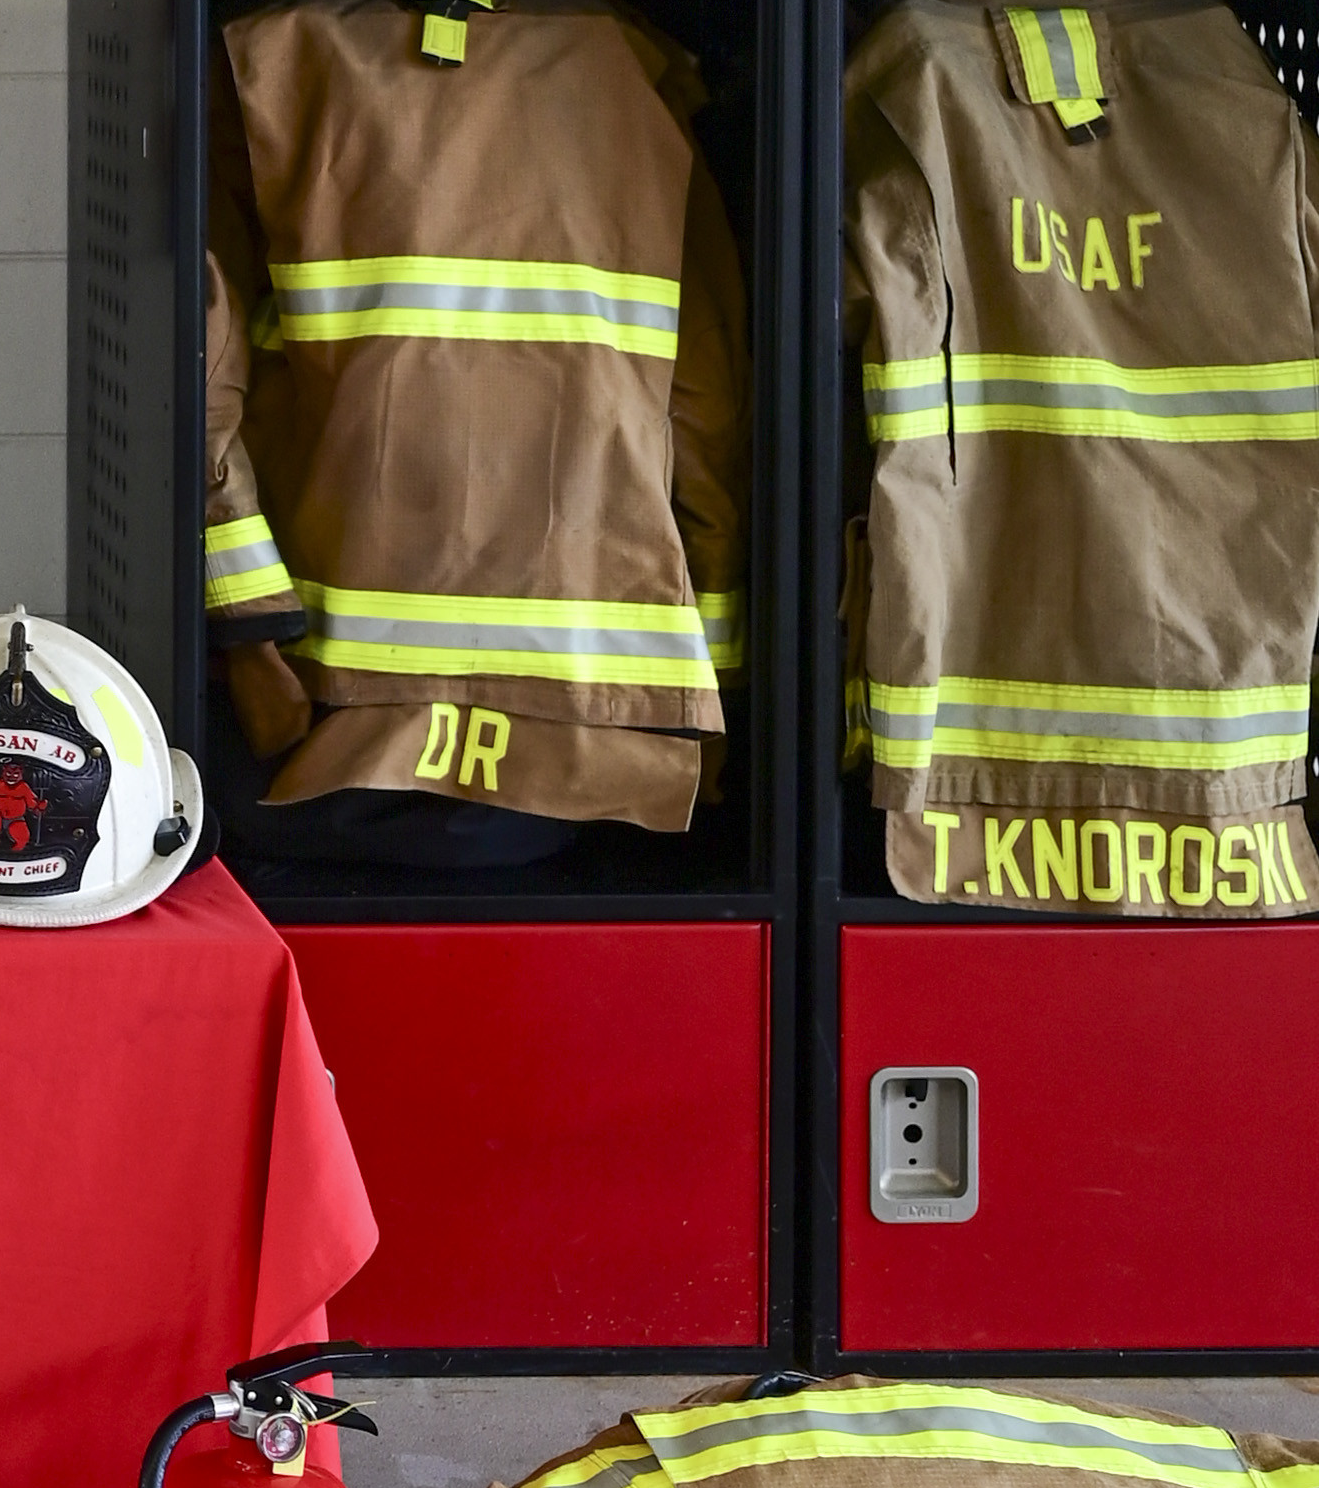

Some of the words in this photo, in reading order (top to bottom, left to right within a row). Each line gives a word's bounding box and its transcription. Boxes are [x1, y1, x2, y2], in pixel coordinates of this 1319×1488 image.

[1011, 197, 1162, 291] USAF
[50, 744, 78, 765] AB
[415, 702, 511, 792] DR
[24, 860, 60, 876] CHIEF
[923, 810, 1308, 908] T.KNOROSKI
